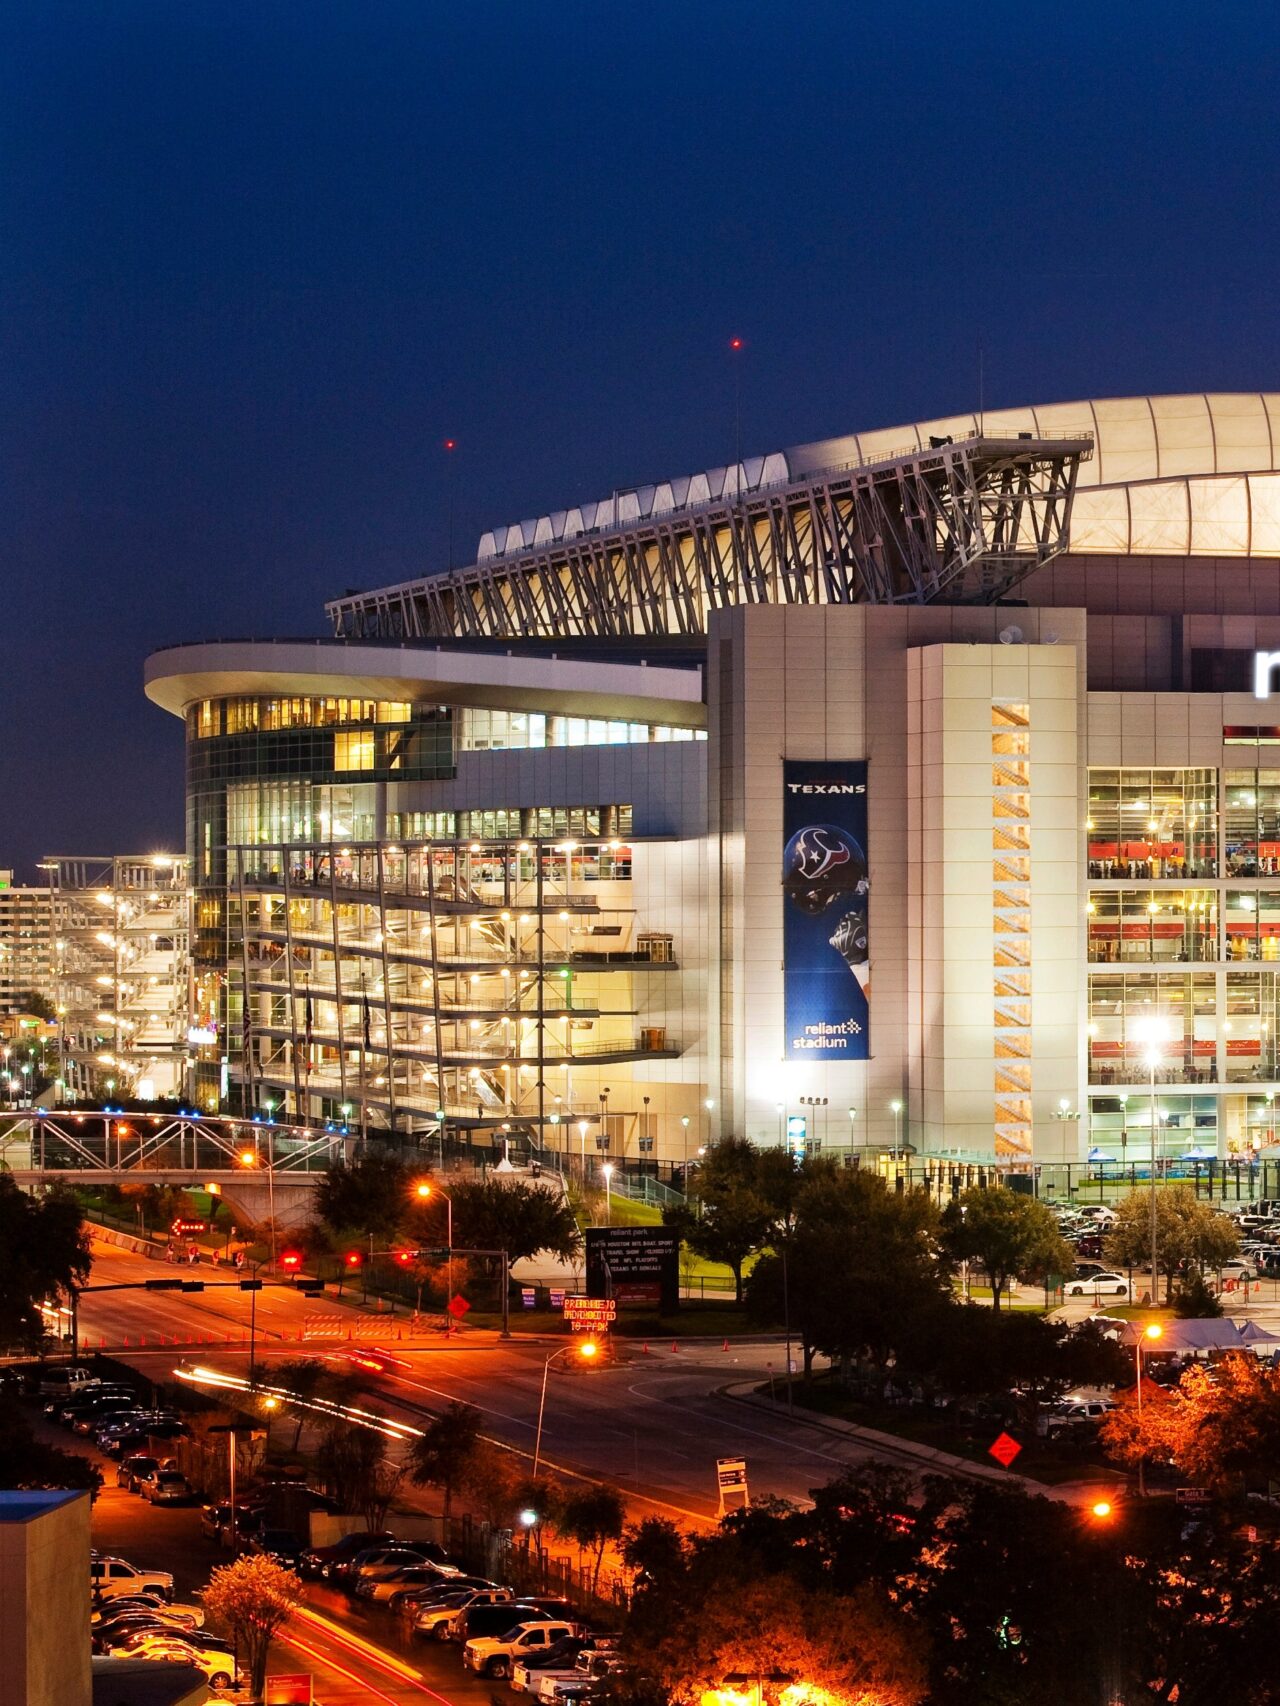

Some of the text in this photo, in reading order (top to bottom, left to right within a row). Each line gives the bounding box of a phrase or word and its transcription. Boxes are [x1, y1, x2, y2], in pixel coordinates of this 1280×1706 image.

[787, 783, 866, 794] TEXANS
[805, 1021, 848, 1034] reliant
[792, 1036, 847, 1048] stadium
